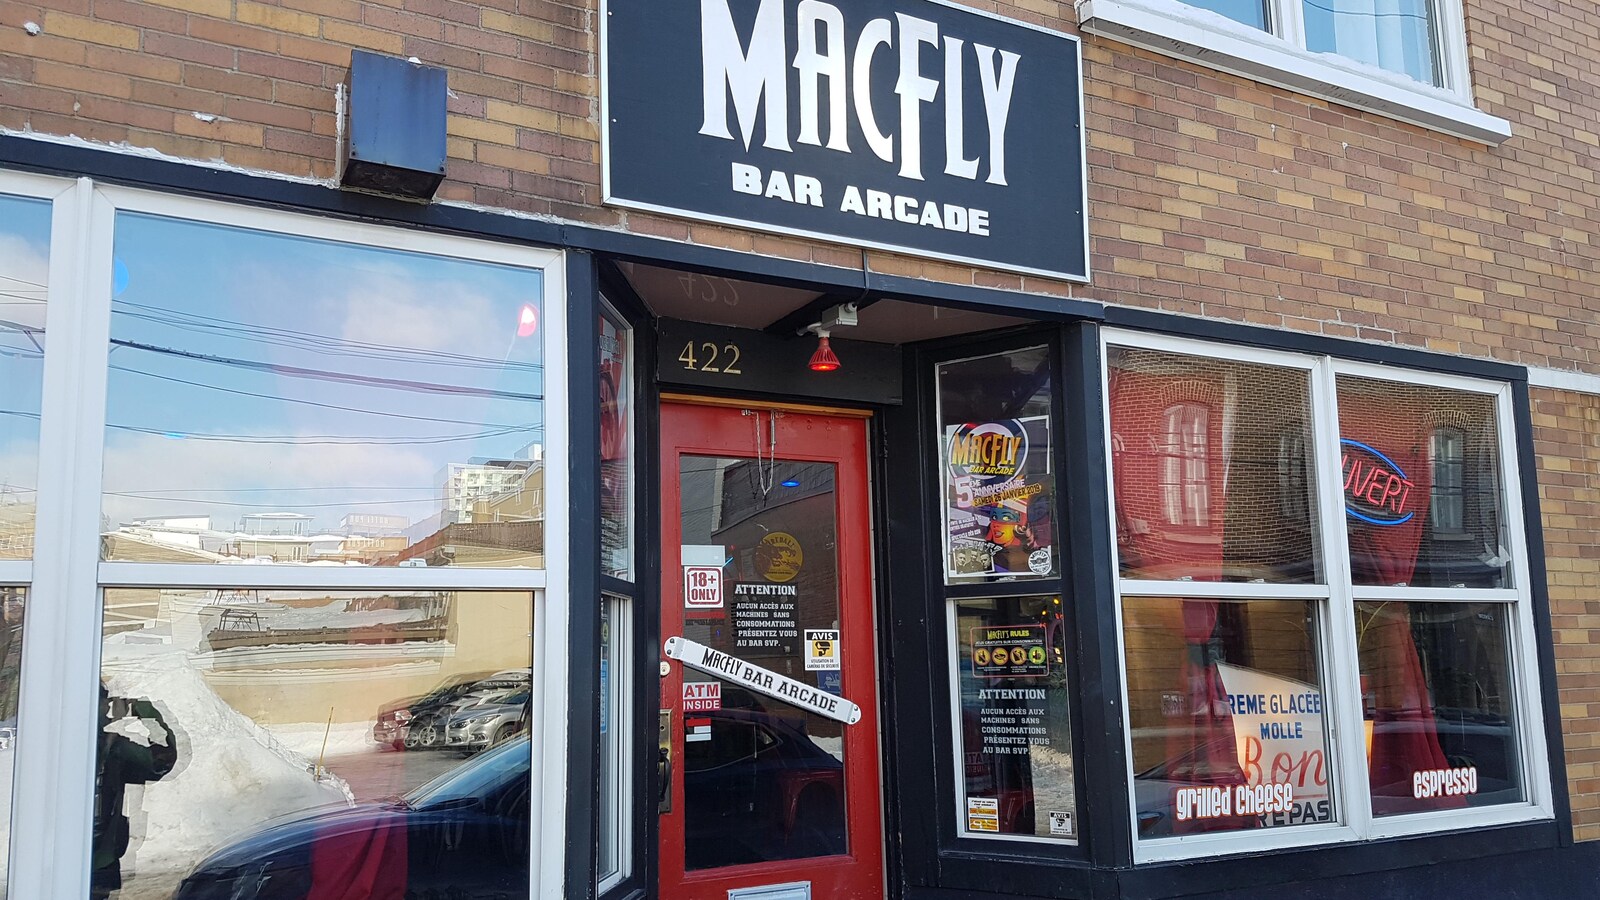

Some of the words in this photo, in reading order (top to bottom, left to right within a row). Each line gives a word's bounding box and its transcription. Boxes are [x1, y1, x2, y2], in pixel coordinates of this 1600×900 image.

[698, 0, 1022, 186] MACFLY
[732, 162, 824, 207] BAR
[840, 186, 990, 236] ARCADE
[678, 340, 742, 375] 422
[951, 431, 1022, 467] MACFLY
[969, 465, 984, 474] BAR
[984, 465, 1015, 475] ARCADE
[973, 479, 1026, 497] ANNIVERSAIRE
[1341, 454, 1415, 514] UVERT
[974, 495, 994, 506] SAMEDI
[1002, 487, 1026, 501] JANVIER
[691, 572, 717, 588] 18+
[691, 588, 717, 601] ONLY
[735, 584, 796, 596] ATTENTION
[760, 602, 779, 610] ACCÈS
[736, 620, 795, 628] CONSOMMATIONS
[738, 628, 778, 637] PRÉSENTEZ
[811, 632, 834, 640] AVIS
[702, 648, 743, 676] MACFLY
[743, 667, 774, 689] BAR
[777, 681, 838, 713] ARCADE
[684, 684, 719, 698] ATM
[979, 689, 1046, 700] ATTENTION
[683, 700, 720, 710] INSIDE
[1005, 707, 1027, 715] ACCÈS
[1227, 694, 1266, 715] REME
[1270, 691, 1321, 714] GLACÉE
[1260, 722, 1303, 740] MOLLE
[984, 735, 1027, 744] PRÉSENTEZ
[1028, 737, 1050, 745] VOUS
[1244, 735, 1328, 788] Bon
[1413, 766, 1478, 799] espresso
[1176, 786, 1232, 821] grilled
[1235, 782, 1294, 816] cheese
